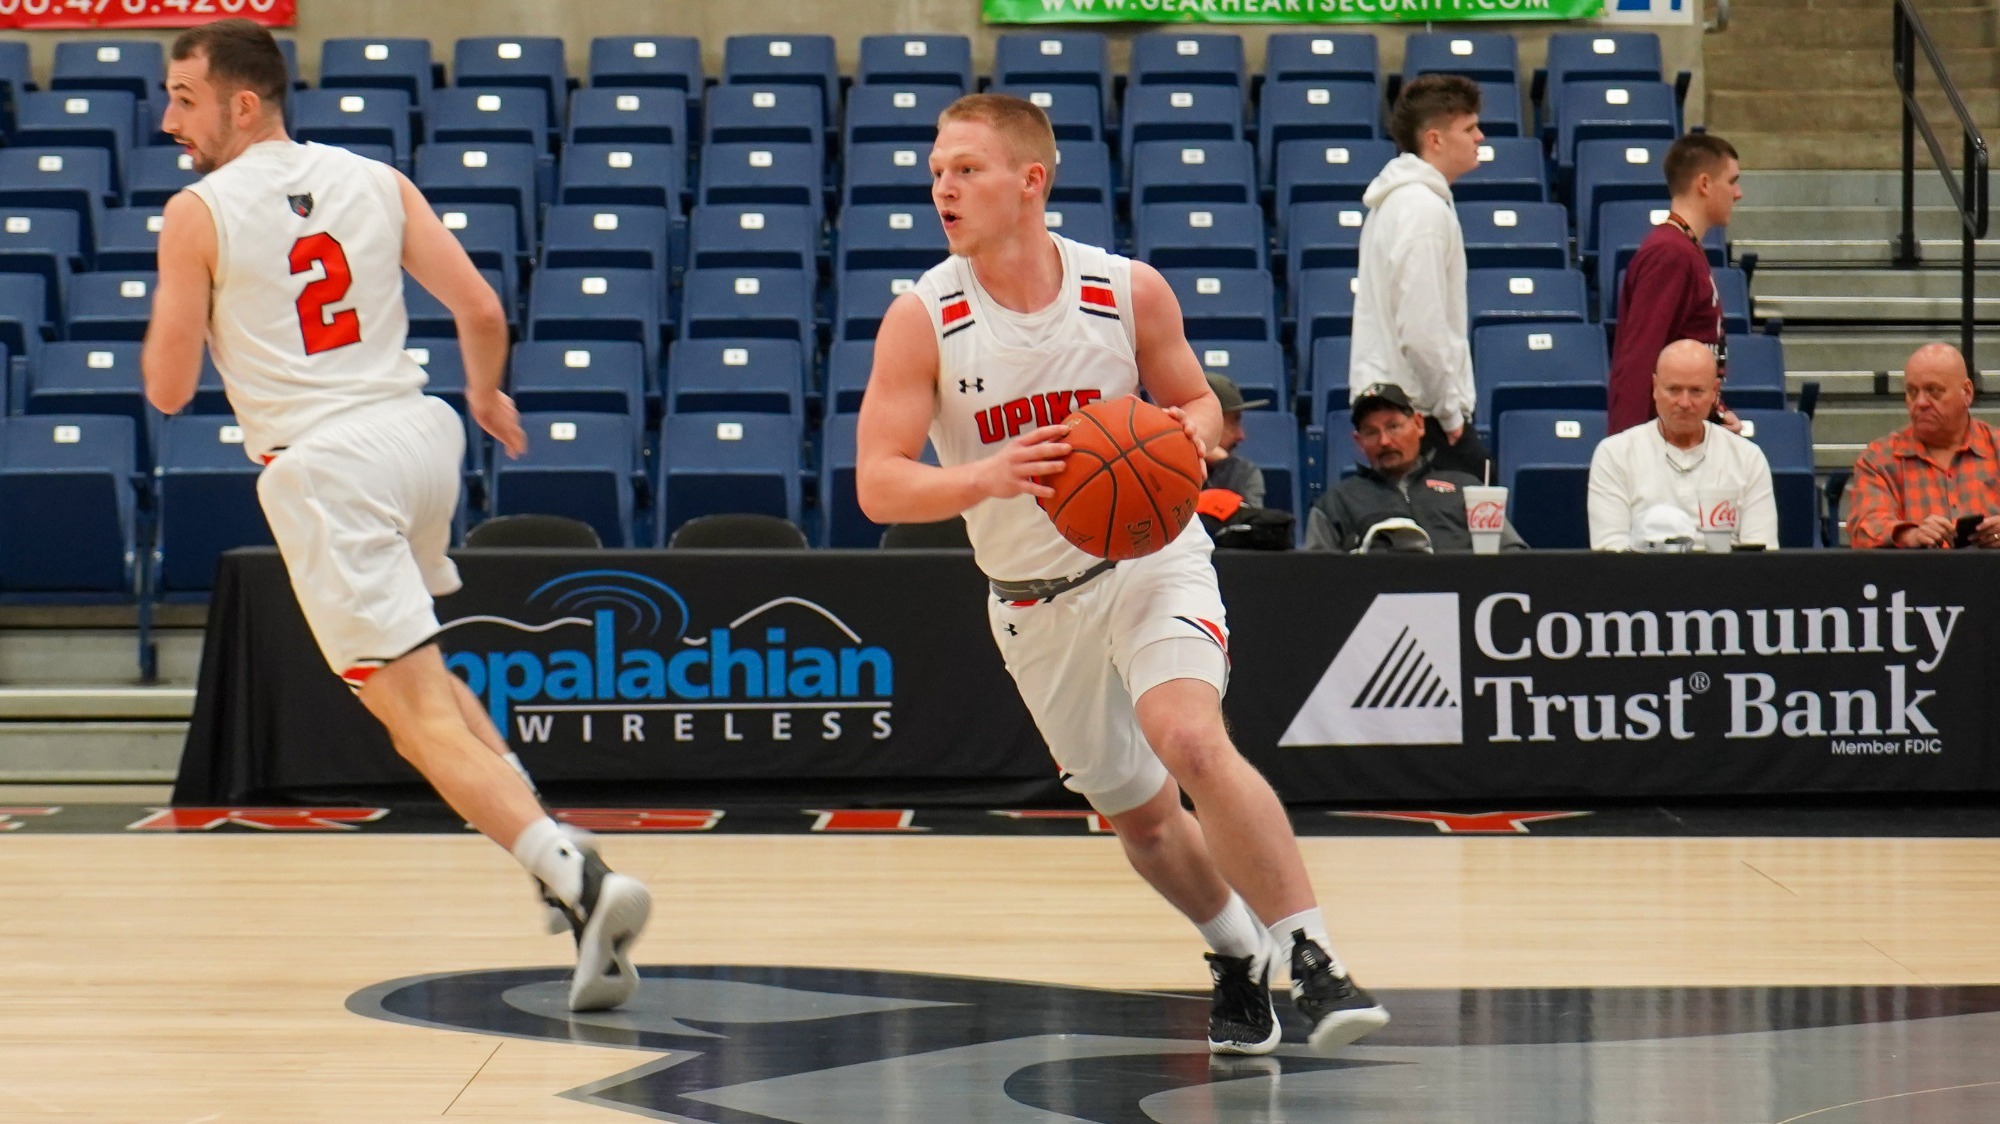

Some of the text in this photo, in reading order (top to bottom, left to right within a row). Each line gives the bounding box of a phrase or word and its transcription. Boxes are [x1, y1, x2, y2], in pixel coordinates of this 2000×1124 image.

[288, 231, 361, 356] 2
[1474, 583, 1965, 673] Community
[517, 711, 893, 743] WIRELESS
[1723, 664, 1939, 739] Bank
[1831, 738, 1942, 755] Member FDIC
